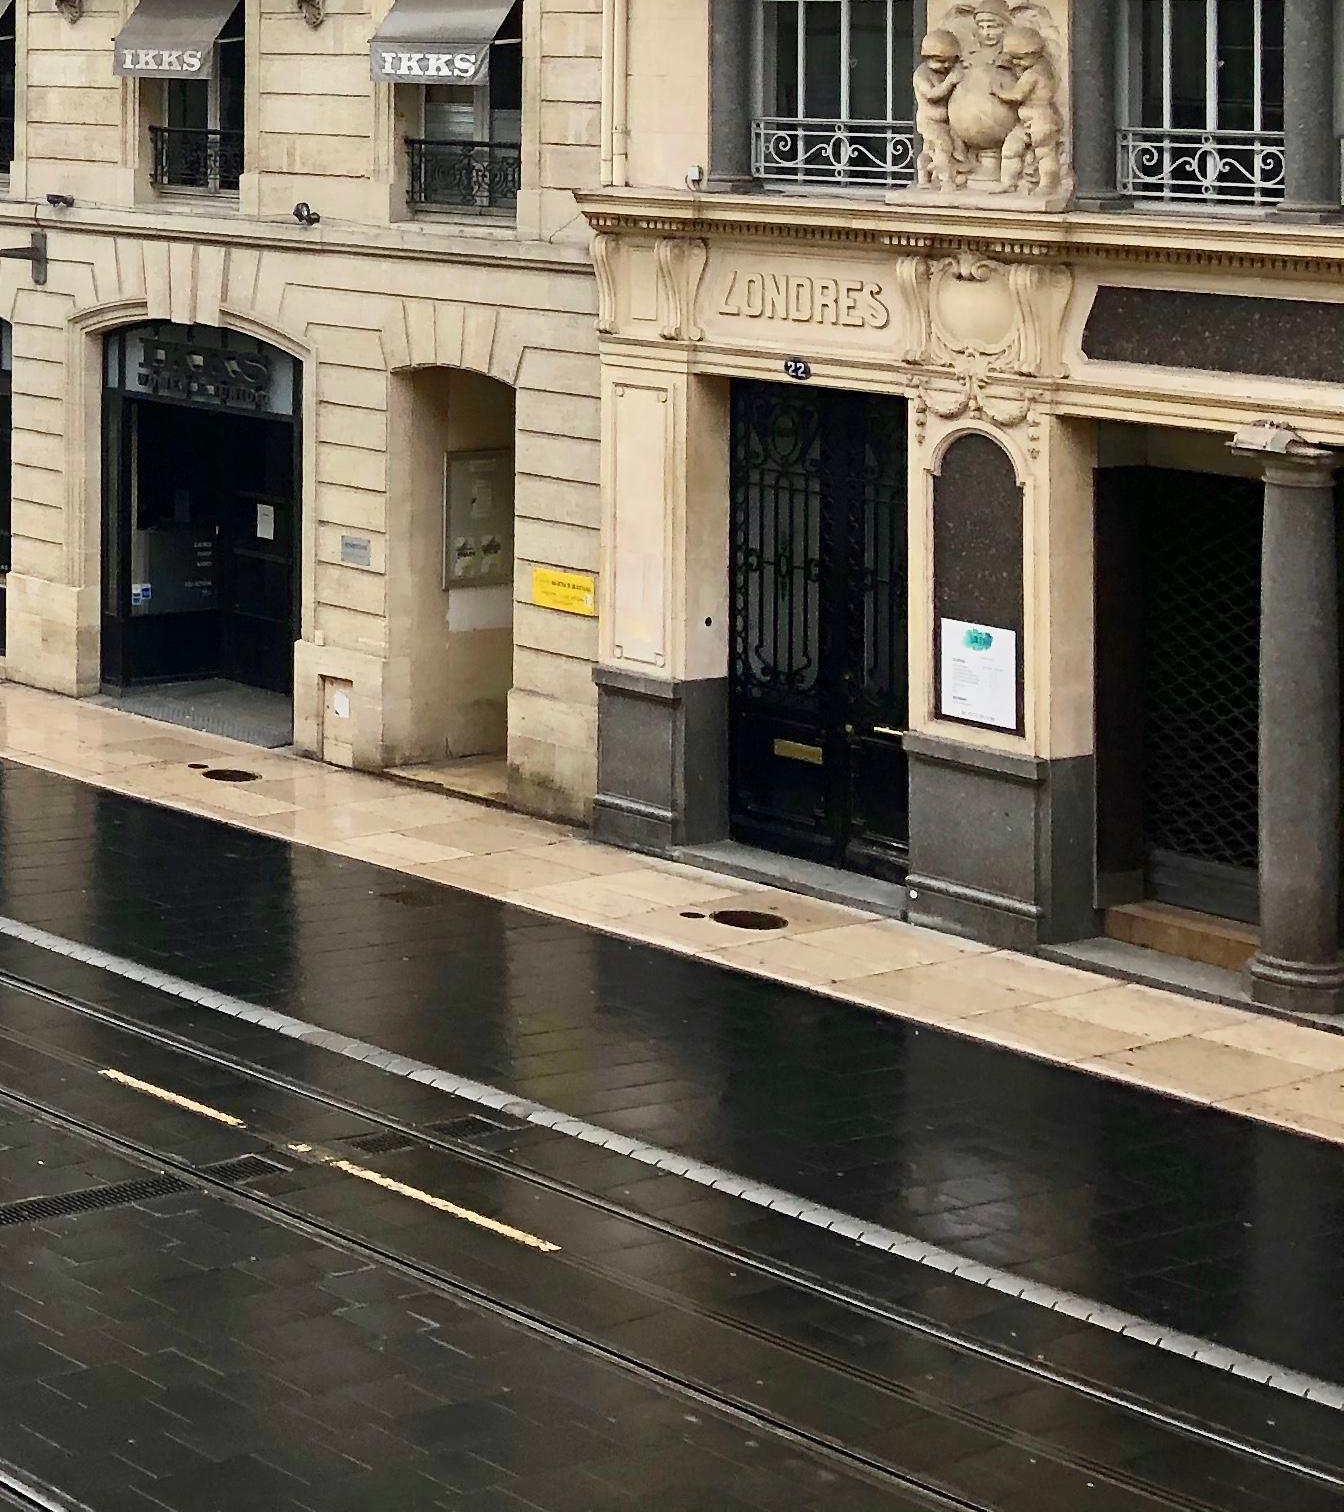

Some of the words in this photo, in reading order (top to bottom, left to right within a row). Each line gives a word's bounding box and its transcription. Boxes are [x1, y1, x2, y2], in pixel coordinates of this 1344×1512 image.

[122, 48, 203, 71] IKKS
[381, 52, 478, 77] IKKS
[718, 270, 890, 330] LONDRES
[787, 361, 806, 377] 22
